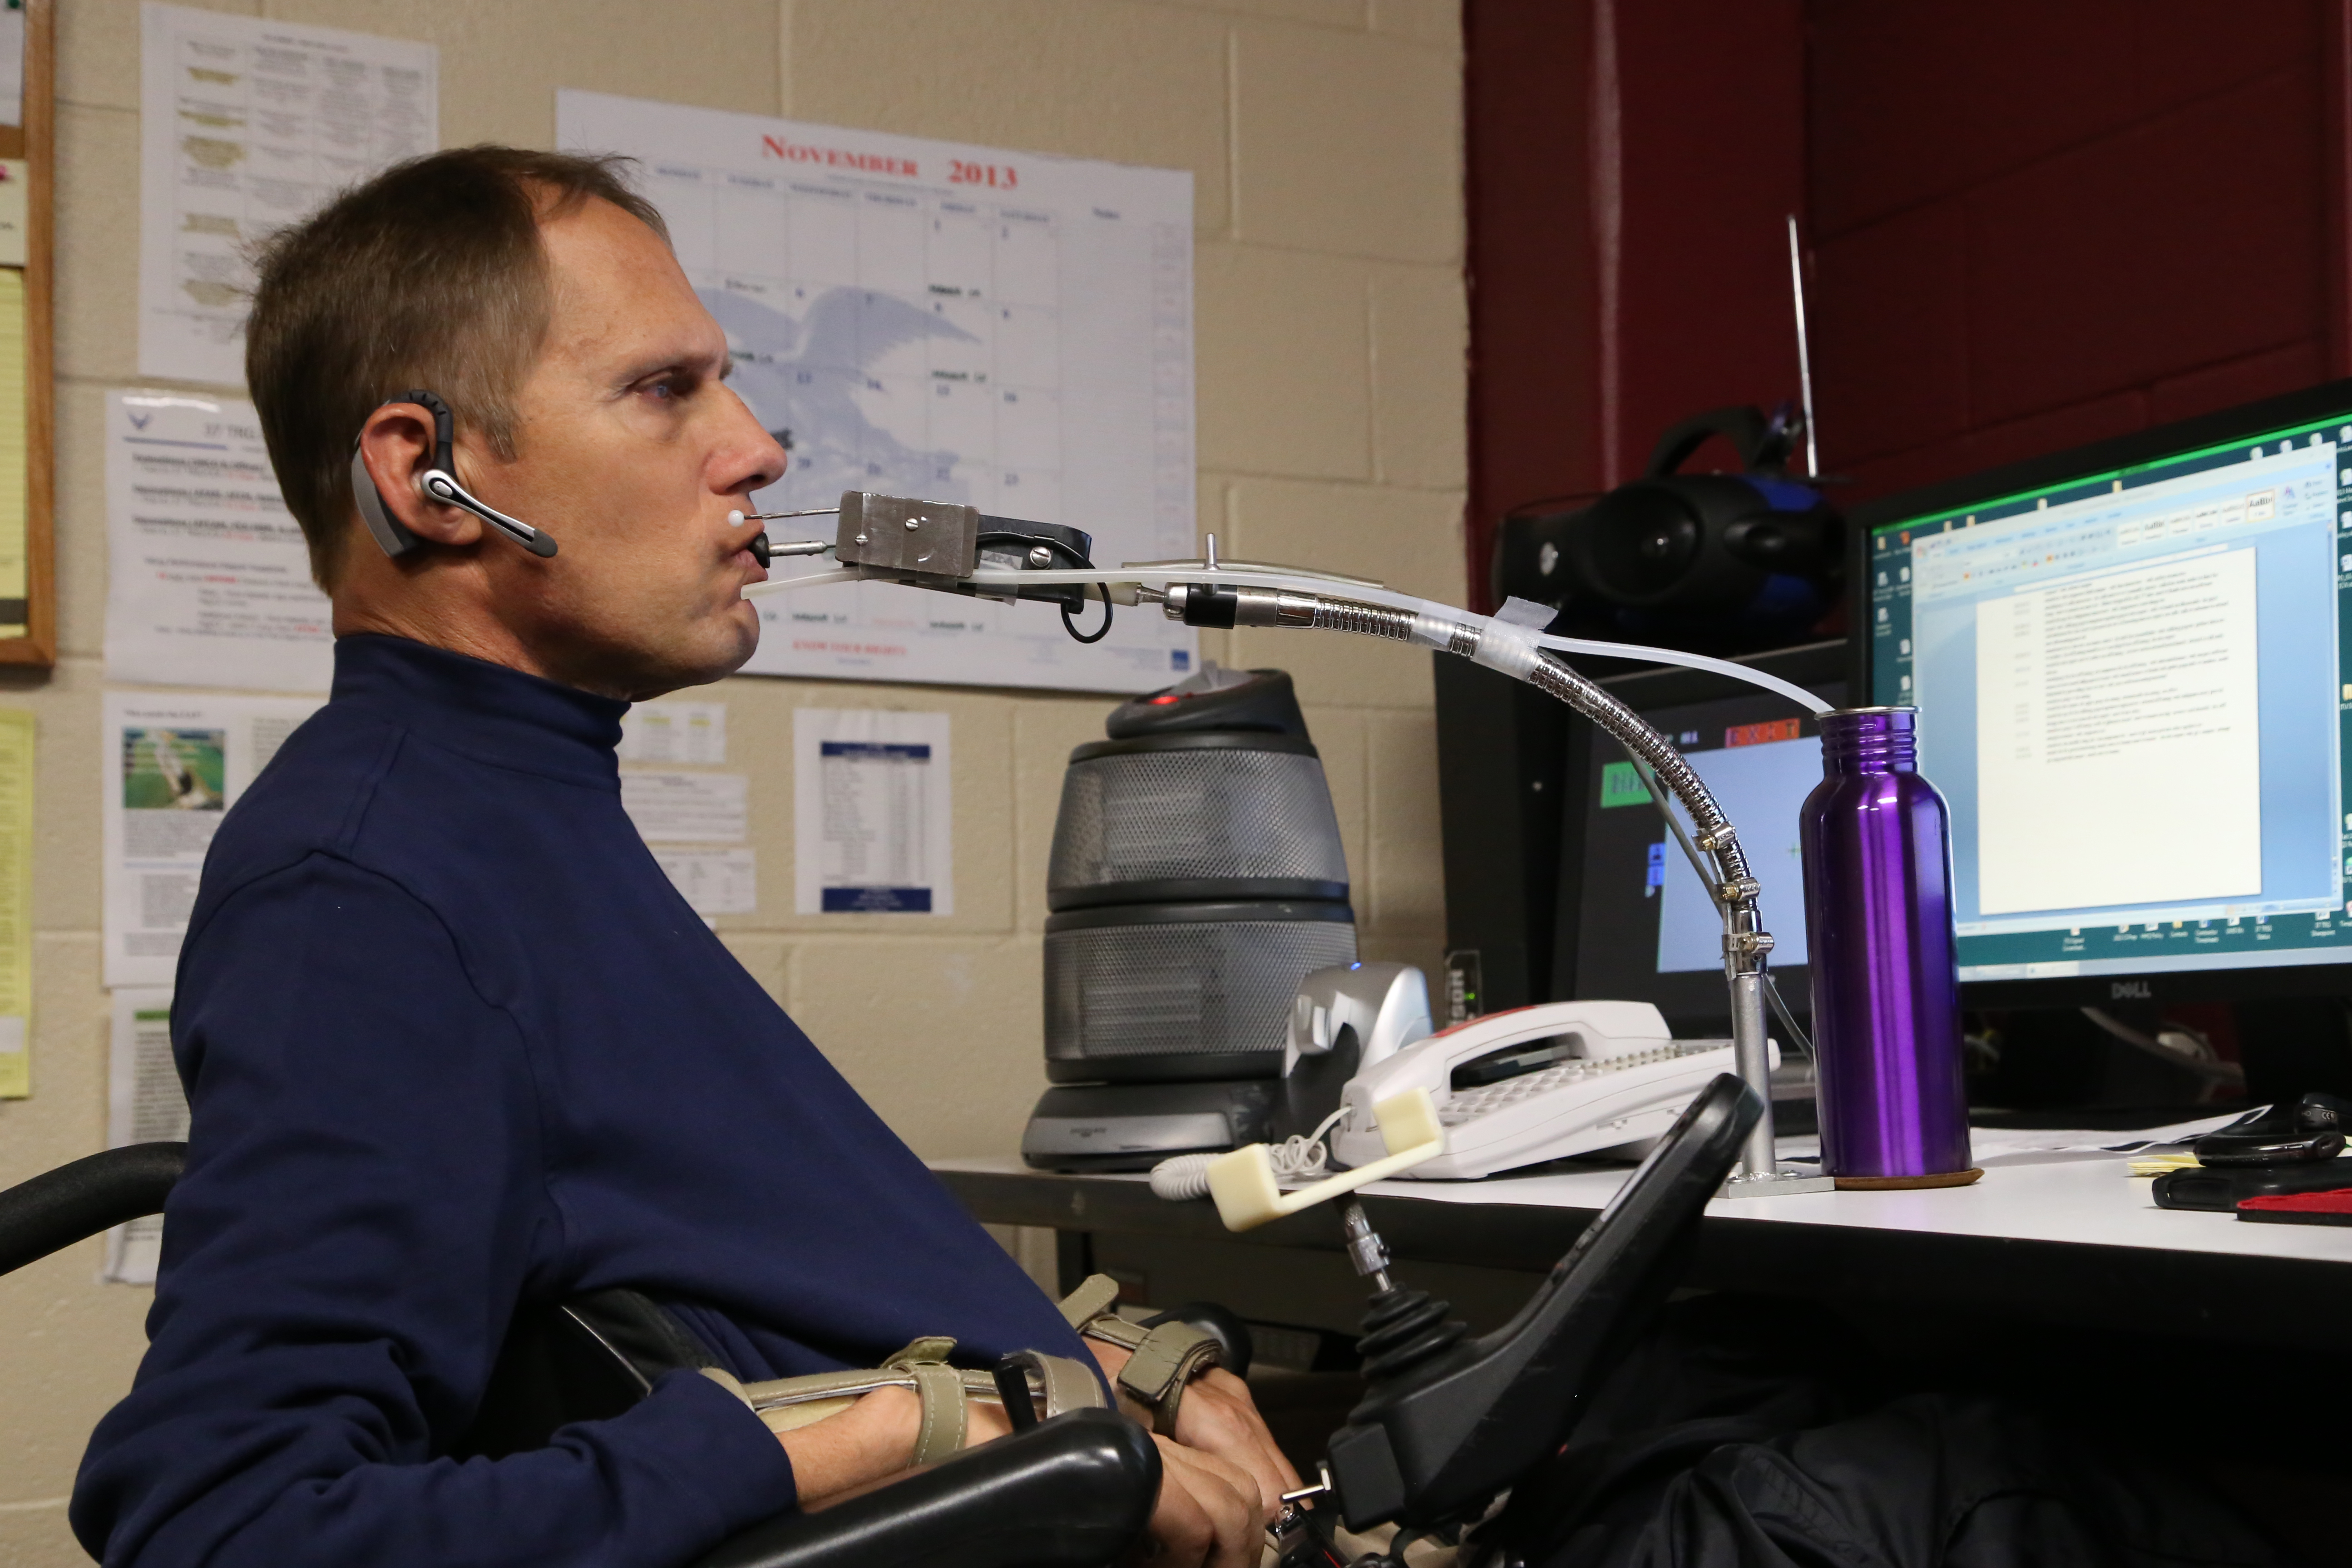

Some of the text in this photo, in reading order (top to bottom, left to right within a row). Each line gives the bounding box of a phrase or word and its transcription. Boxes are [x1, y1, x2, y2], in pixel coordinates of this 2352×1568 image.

[948, 159, 1018, 190] 2013
[1730, 722, 1794, 746] EXIT
[2112, 981, 2152, 1000] DELL
